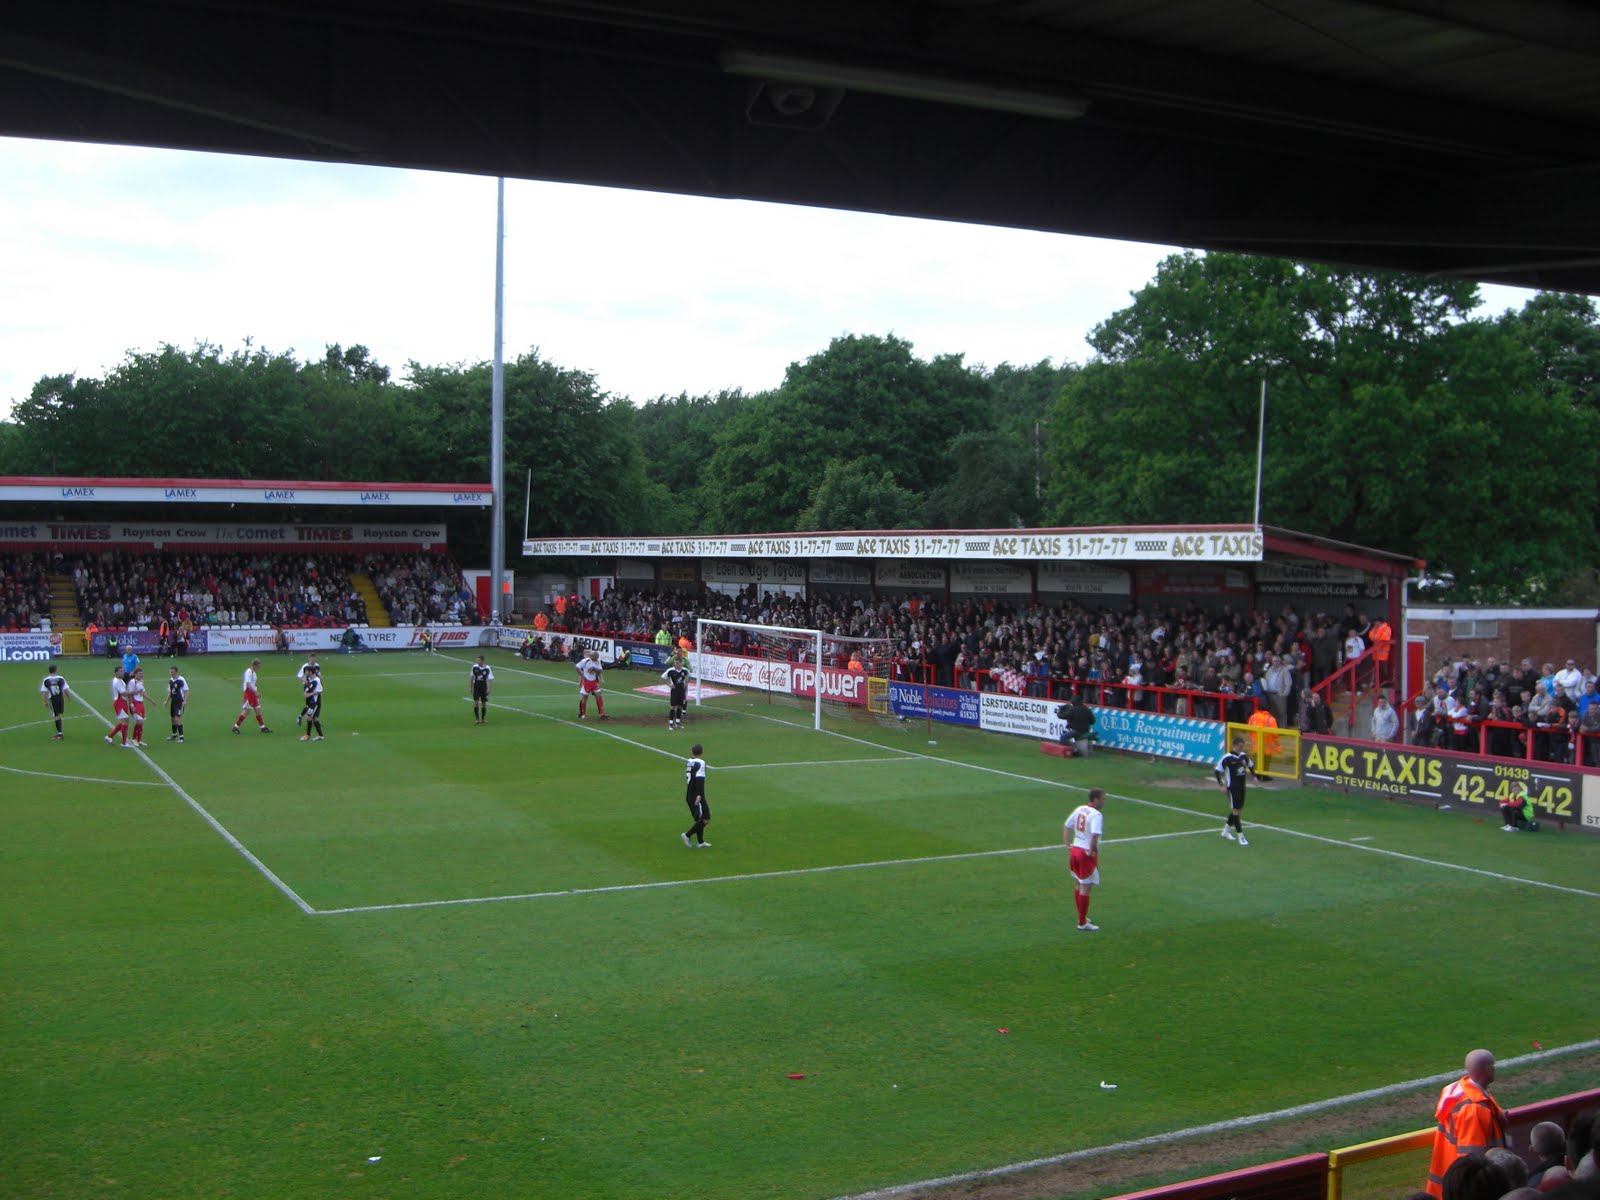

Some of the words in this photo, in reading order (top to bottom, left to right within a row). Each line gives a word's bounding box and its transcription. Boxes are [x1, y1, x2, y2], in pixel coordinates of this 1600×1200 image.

[62, 488, 95, 497] LAMEX
[165, 489, 197, 498] LAMEX
[264, 490, 295, 499] LAMEX
[360, 492, 390, 501] LAMEX
[453, 493, 482, 502] LAMEX
[48, 524, 111, 539] TIMES
[123, 528, 171, 538] Royston
[177, 528, 207, 537] Crow
[236, 526, 285, 539] Comet
[295, 526, 352, 541] TIMES
[364, 529, 408, 538] Royston
[413, 529, 441, 538] Crow
[602, 542, 619, 553] TAXIS
[675, 541, 695, 554] TAXIS
[698, 541, 727, 554] 31-77-77
[765, 540, 790, 554] TAXIS
[794, 540, 832, 554] 31-77-77
[879, 538, 910, 555] TAXIS
[914, 538, 960, 555] 31-77-77
[1021, 537, 1061, 556] TAXIS
[1068, 537, 1128, 557] 31-77-77
[1209, 535, 1262, 557] TAXIS
[367, 633, 397, 642] TYRE?
[899, 688, 922, 705] Noble
[961, 703, 977, 712] 07000
[982, 697, 1048, 714] LSRSTORAGE.COM
[959, 711, 979, 720] 818283
[1101, 716, 1131, 731] Q.E.D.
[1136, 720, 1212, 743] Recruitment
[1117, 734, 1132, 743] Tel:
[1157, 739, 1185, 751] 748548
[1306, 744, 1355, 774] ABC
[1362, 751, 1443, 787] TAXIS
[1494, 765, 1529, 780] 01438
[1335, 775, 1408, 794] STEVENAGE
